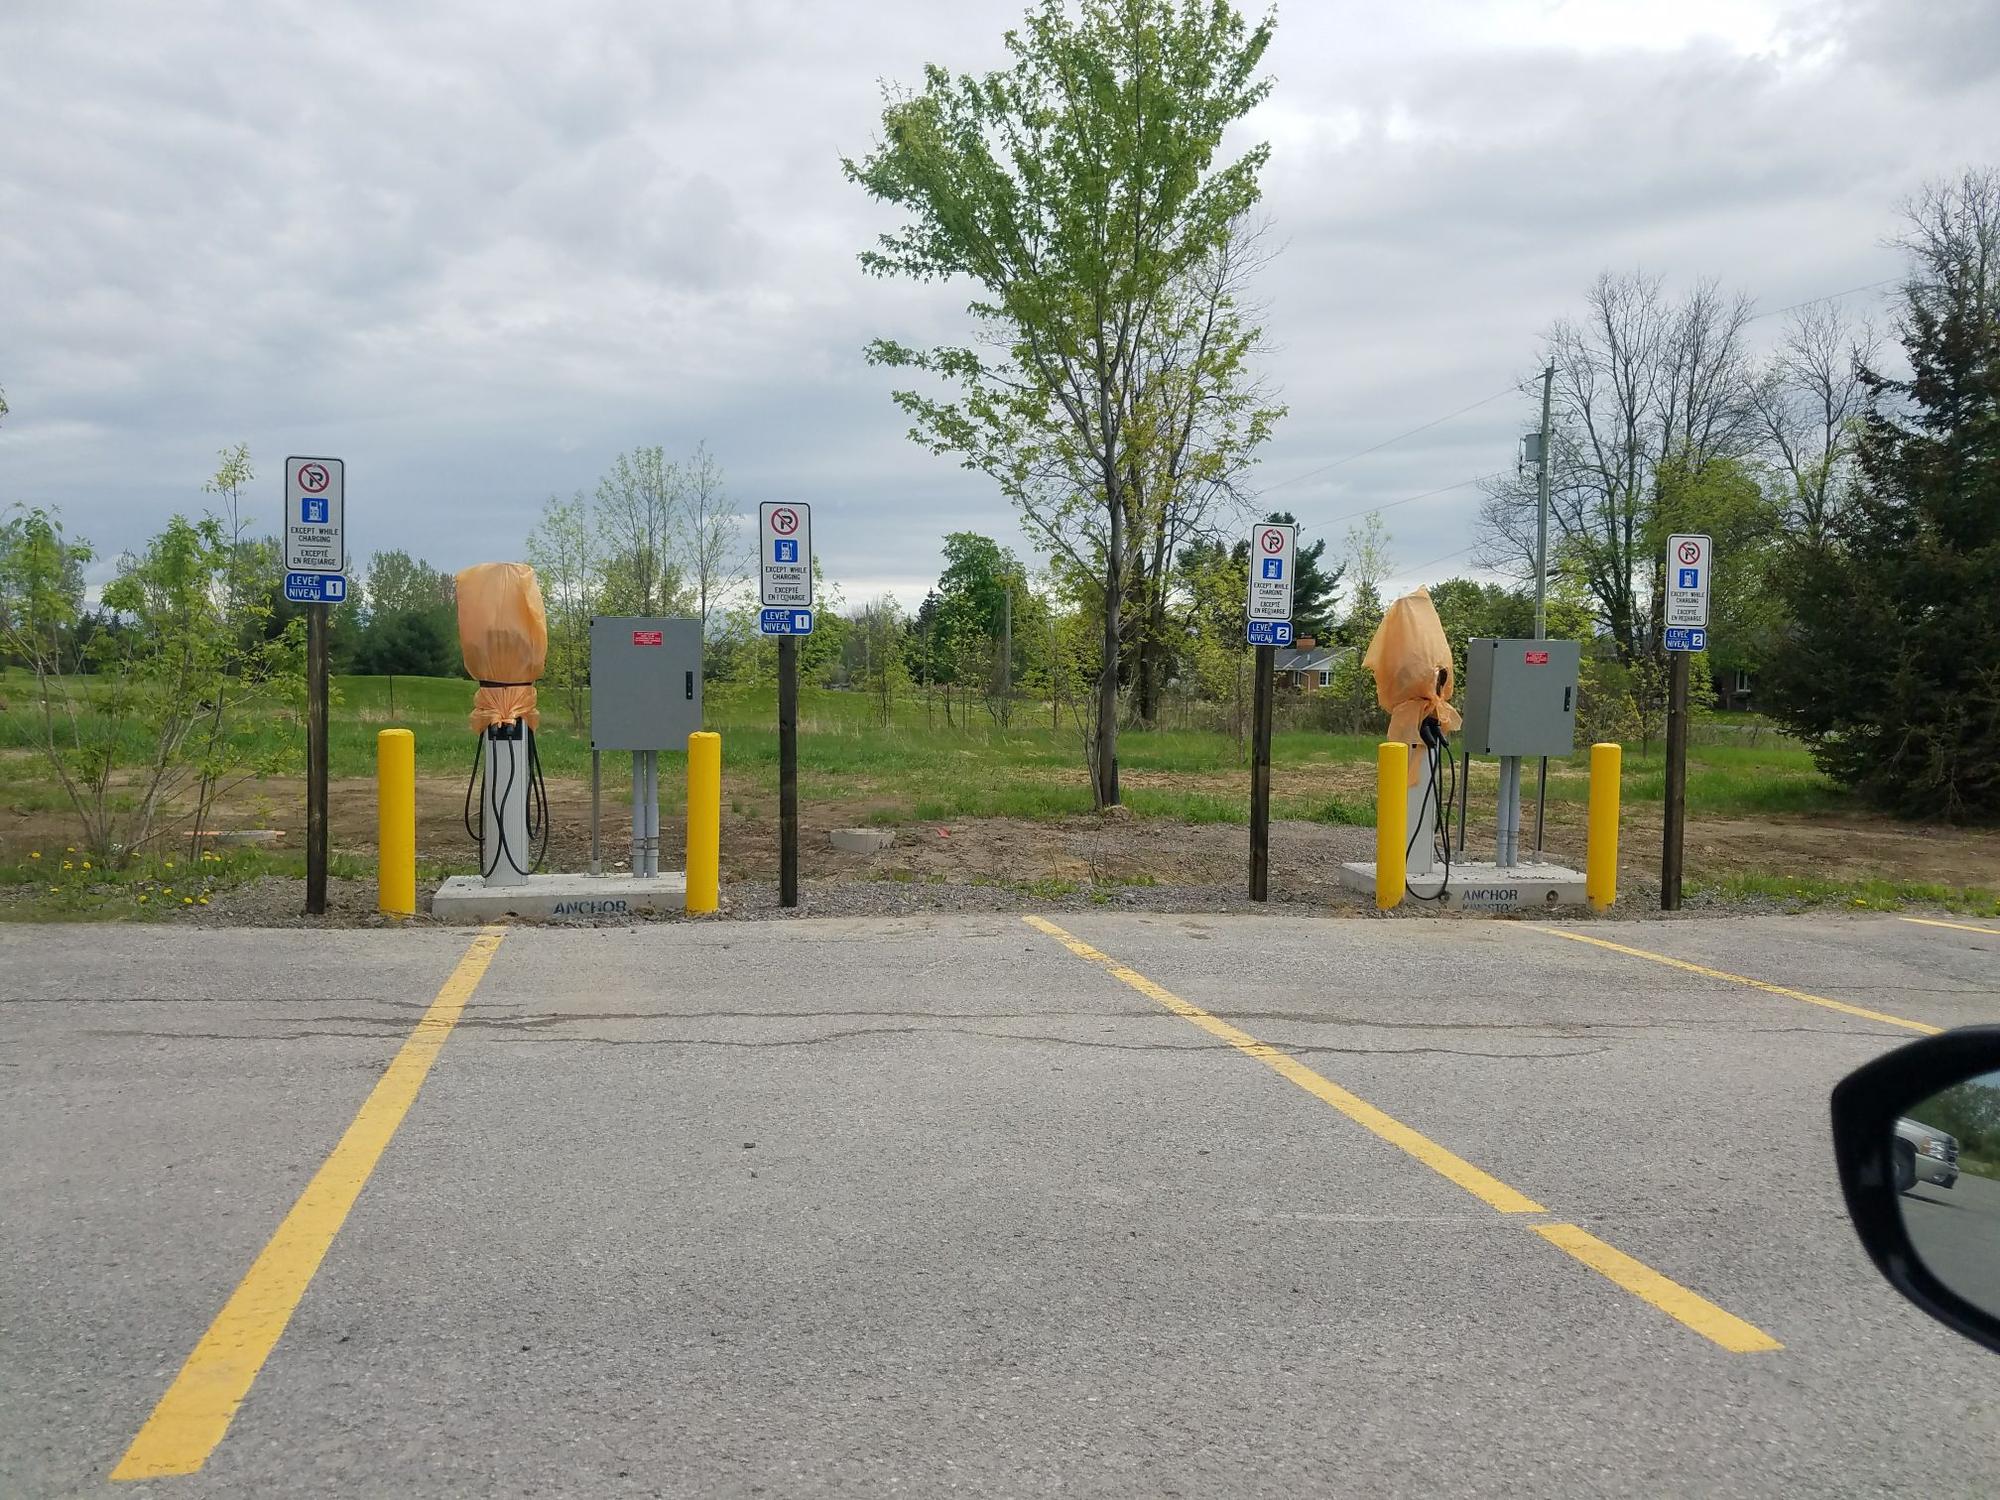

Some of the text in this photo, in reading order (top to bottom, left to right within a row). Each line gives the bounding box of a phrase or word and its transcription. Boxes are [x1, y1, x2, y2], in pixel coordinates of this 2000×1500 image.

[309, 472, 323, 487] P
[781, 515, 793, 529] P
[291, 527, 315, 535] EXCEPT
[298, 535, 331, 543] CHARGING
[1269, 536, 1280, 549] P
[1685, 547, 1696, 560] P
[790, 566, 807, 574] WHILE
[291, 575, 319, 586] LEVEL
[289, 588, 320, 598] NIVEAU
[768, 593, 776, 601] EN
[765, 611, 789, 620] LEVEL
[763, 623, 791, 632] NIVEAU
[1252, 623, 1272, 632] LEVEL
[1250, 633, 1274, 642] NIVEAU
[1462, 889, 1518, 900] ANCHOR
[553, 900, 627, 914] ANCHOR
